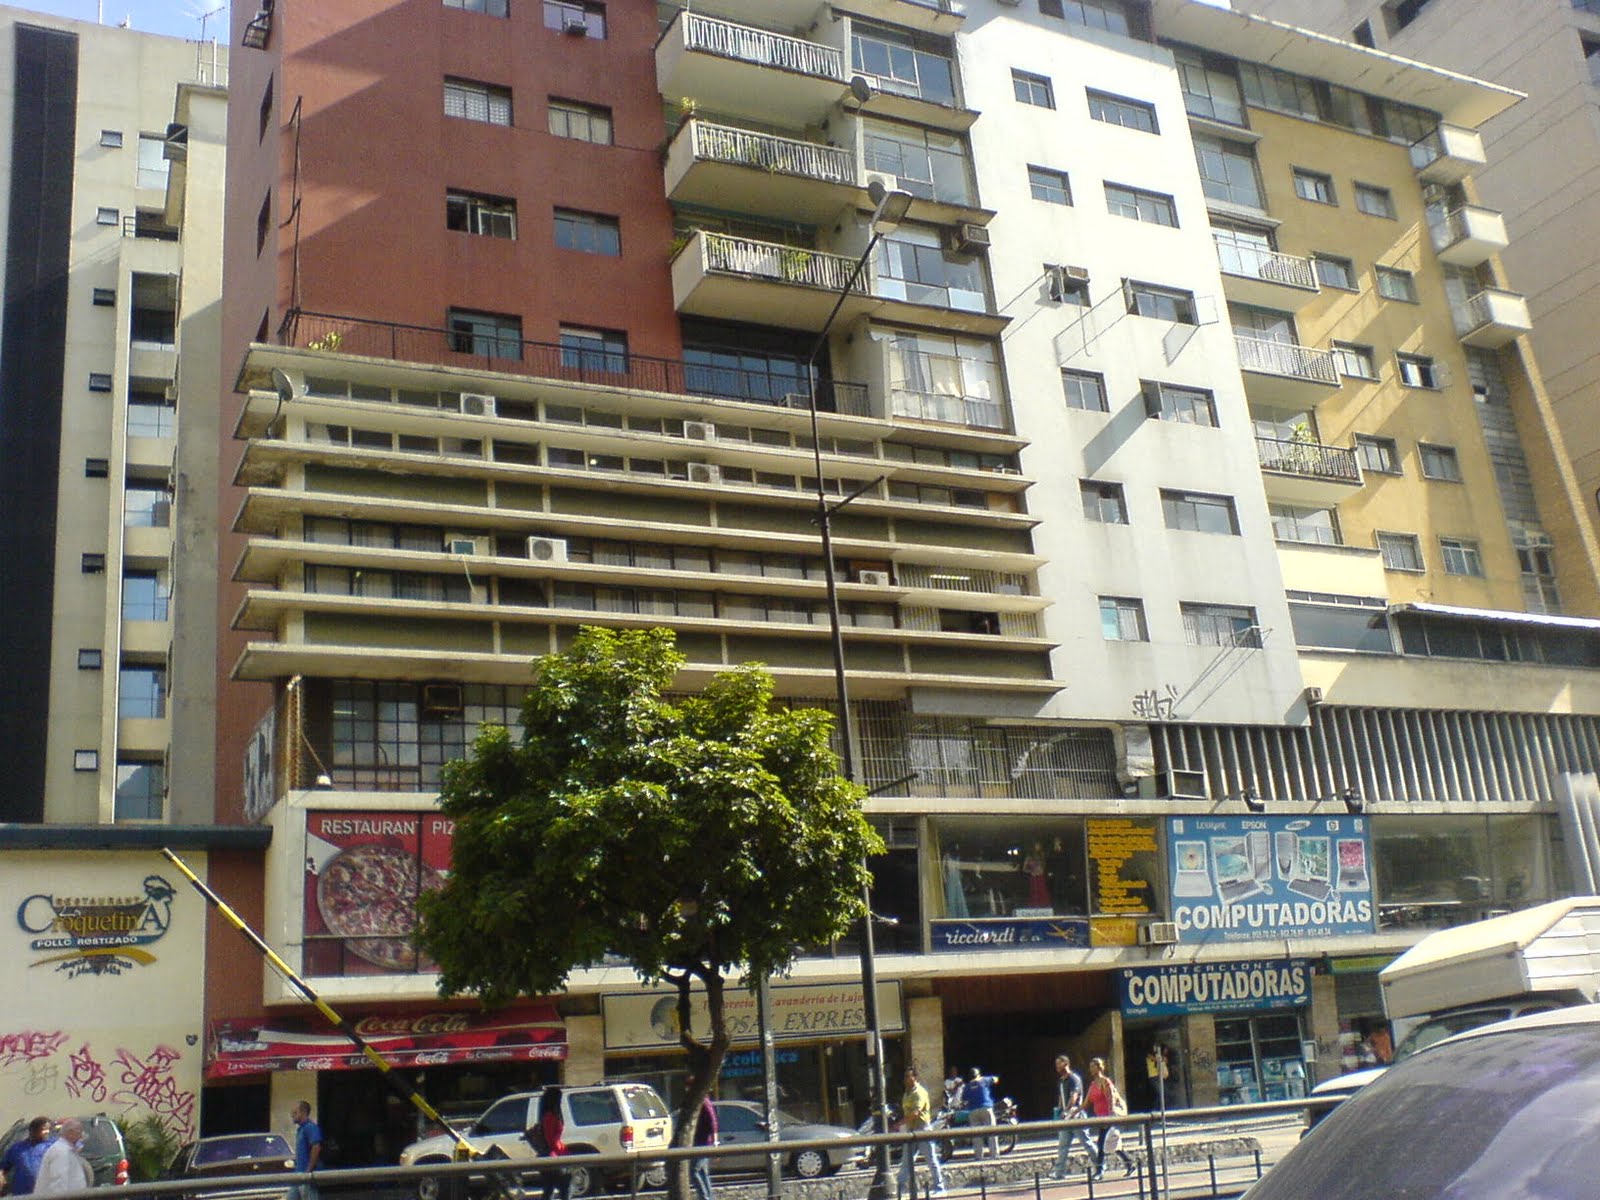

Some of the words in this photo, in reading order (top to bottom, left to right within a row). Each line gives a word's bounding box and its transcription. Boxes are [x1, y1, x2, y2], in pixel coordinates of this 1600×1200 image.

[1174, 900, 1372, 930] COMPUTADORAS
[37, 938, 73, 948] POLLO
[77, 936, 138, 946] ROSTIZADO
[1128, 967, 1305, 1005] COMPUTADORAS
[784, 1008, 867, 1030] EXPRES
